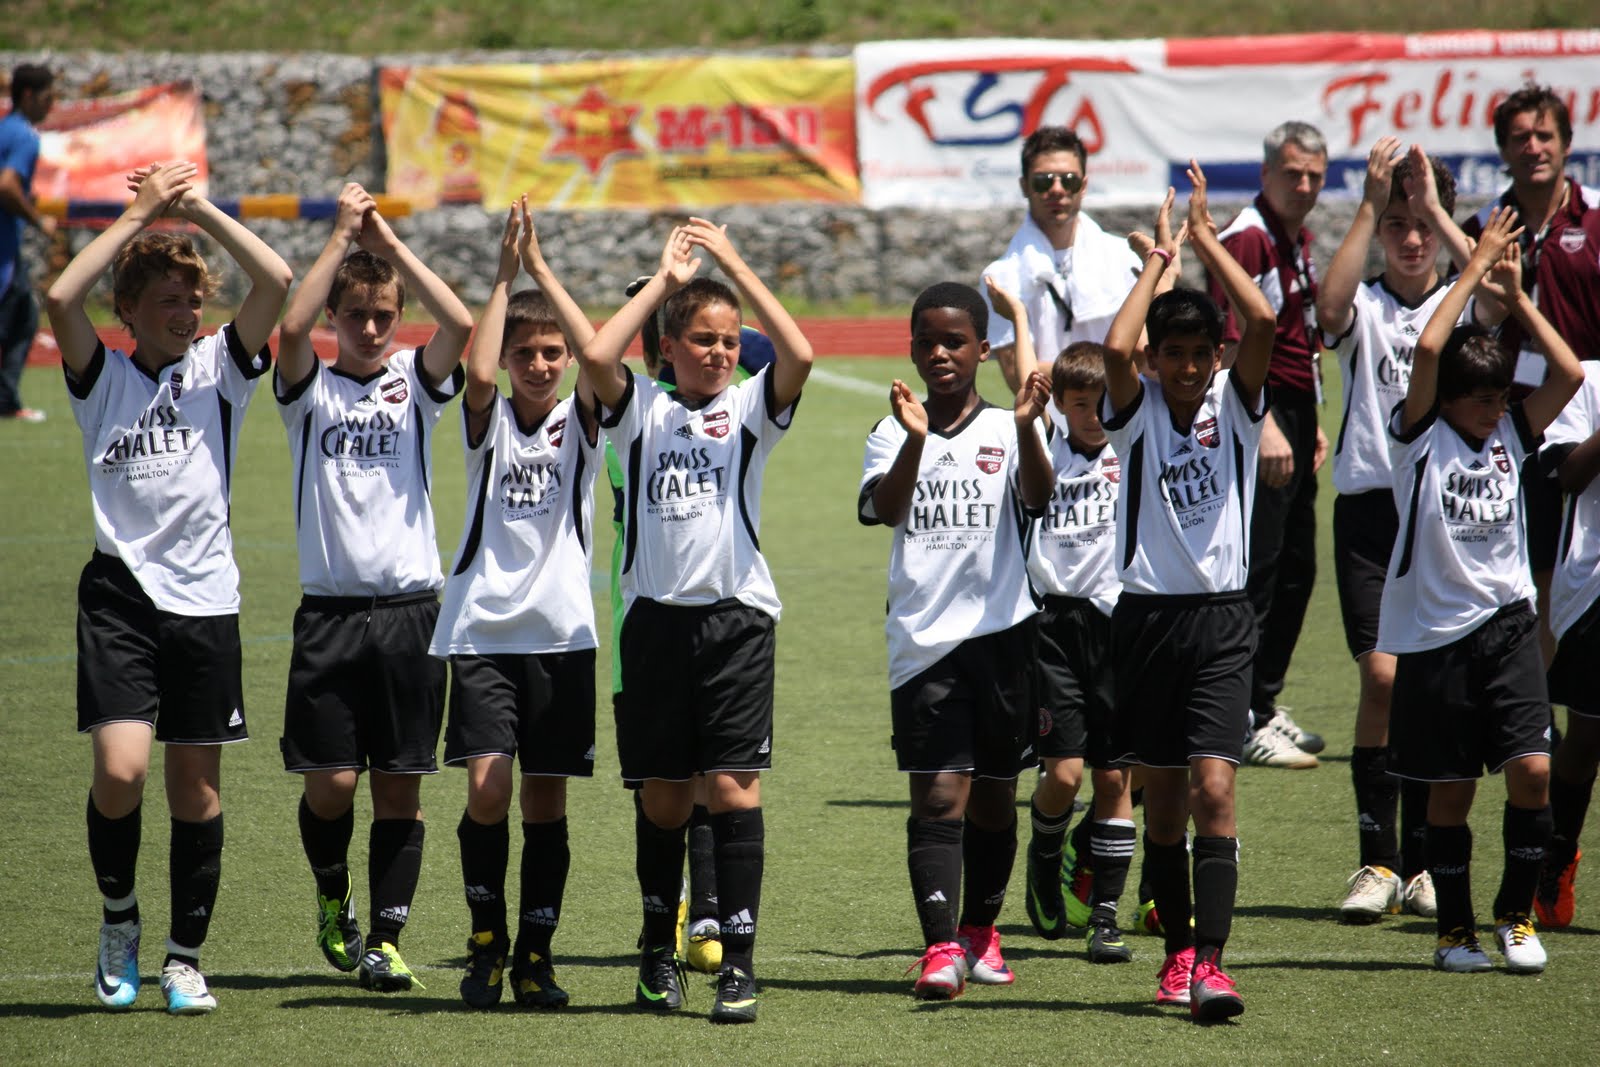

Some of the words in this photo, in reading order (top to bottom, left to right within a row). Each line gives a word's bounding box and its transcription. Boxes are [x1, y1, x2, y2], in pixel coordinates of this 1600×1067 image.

[126, 469, 170, 482] HAMILTON
[340, 470, 381, 478] HAMILTON
[915, 479, 983, 501] SWISS
[1446, 472, 1503, 500] SWISS
[660, 511, 703, 523] HAMILTON
[1441, 494, 1515, 523] HALET
[906, 503, 995, 534] HALET
[925, 543, 967, 551] HAMILTON
